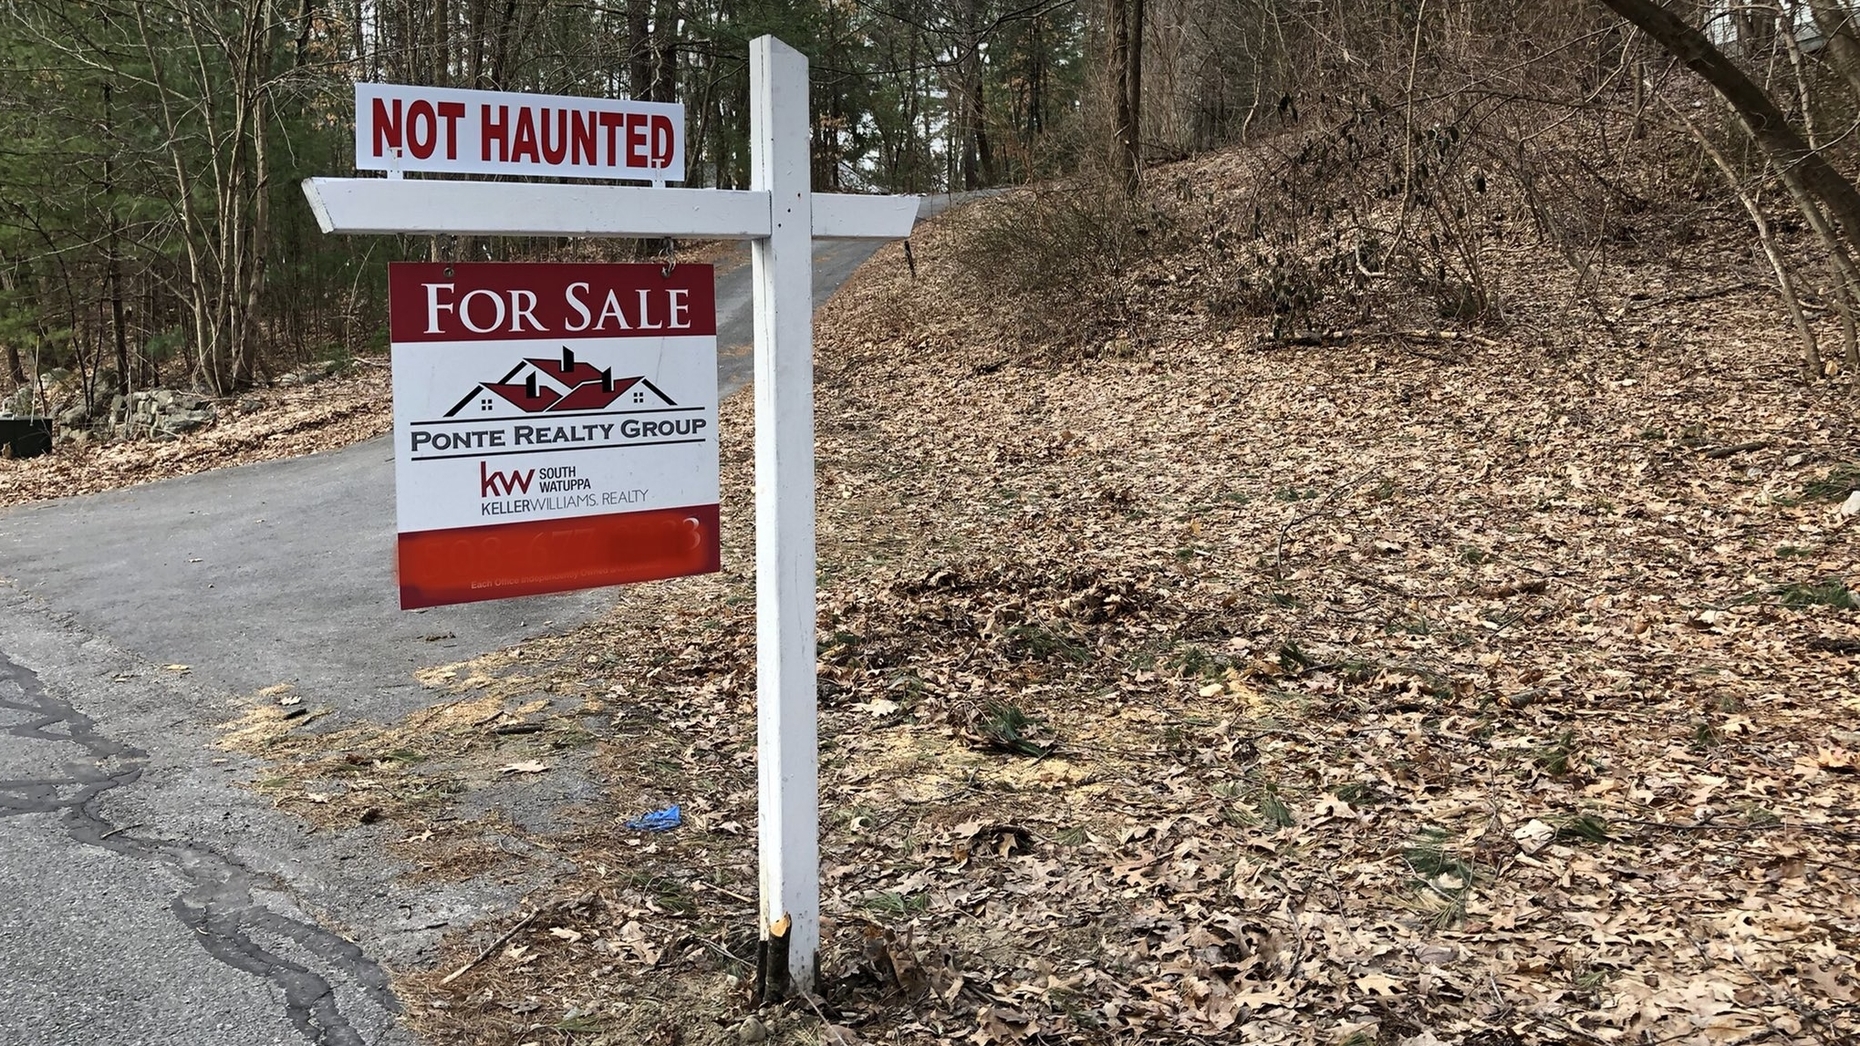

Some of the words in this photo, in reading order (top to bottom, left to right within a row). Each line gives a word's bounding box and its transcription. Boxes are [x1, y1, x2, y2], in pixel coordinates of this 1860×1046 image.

[372, 97, 466, 161] NOT
[481, 104, 675, 169] HAUNTED
[421, 282, 550, 334] FOR
[564, 282, 692, 332] SALE
[410, 429, 505, 452] PONTE
[513, 422, 614, 446] REALTY
[620, 418, 707, 438] GROUP
[480, 461, 536, 498] kw
[539, 466, 576, 480] SOUTH
[539, 478, 591, 494] WATUPPA
[602, 489, 649, 506] REALTY
[471, 581, 493, 590] Each
